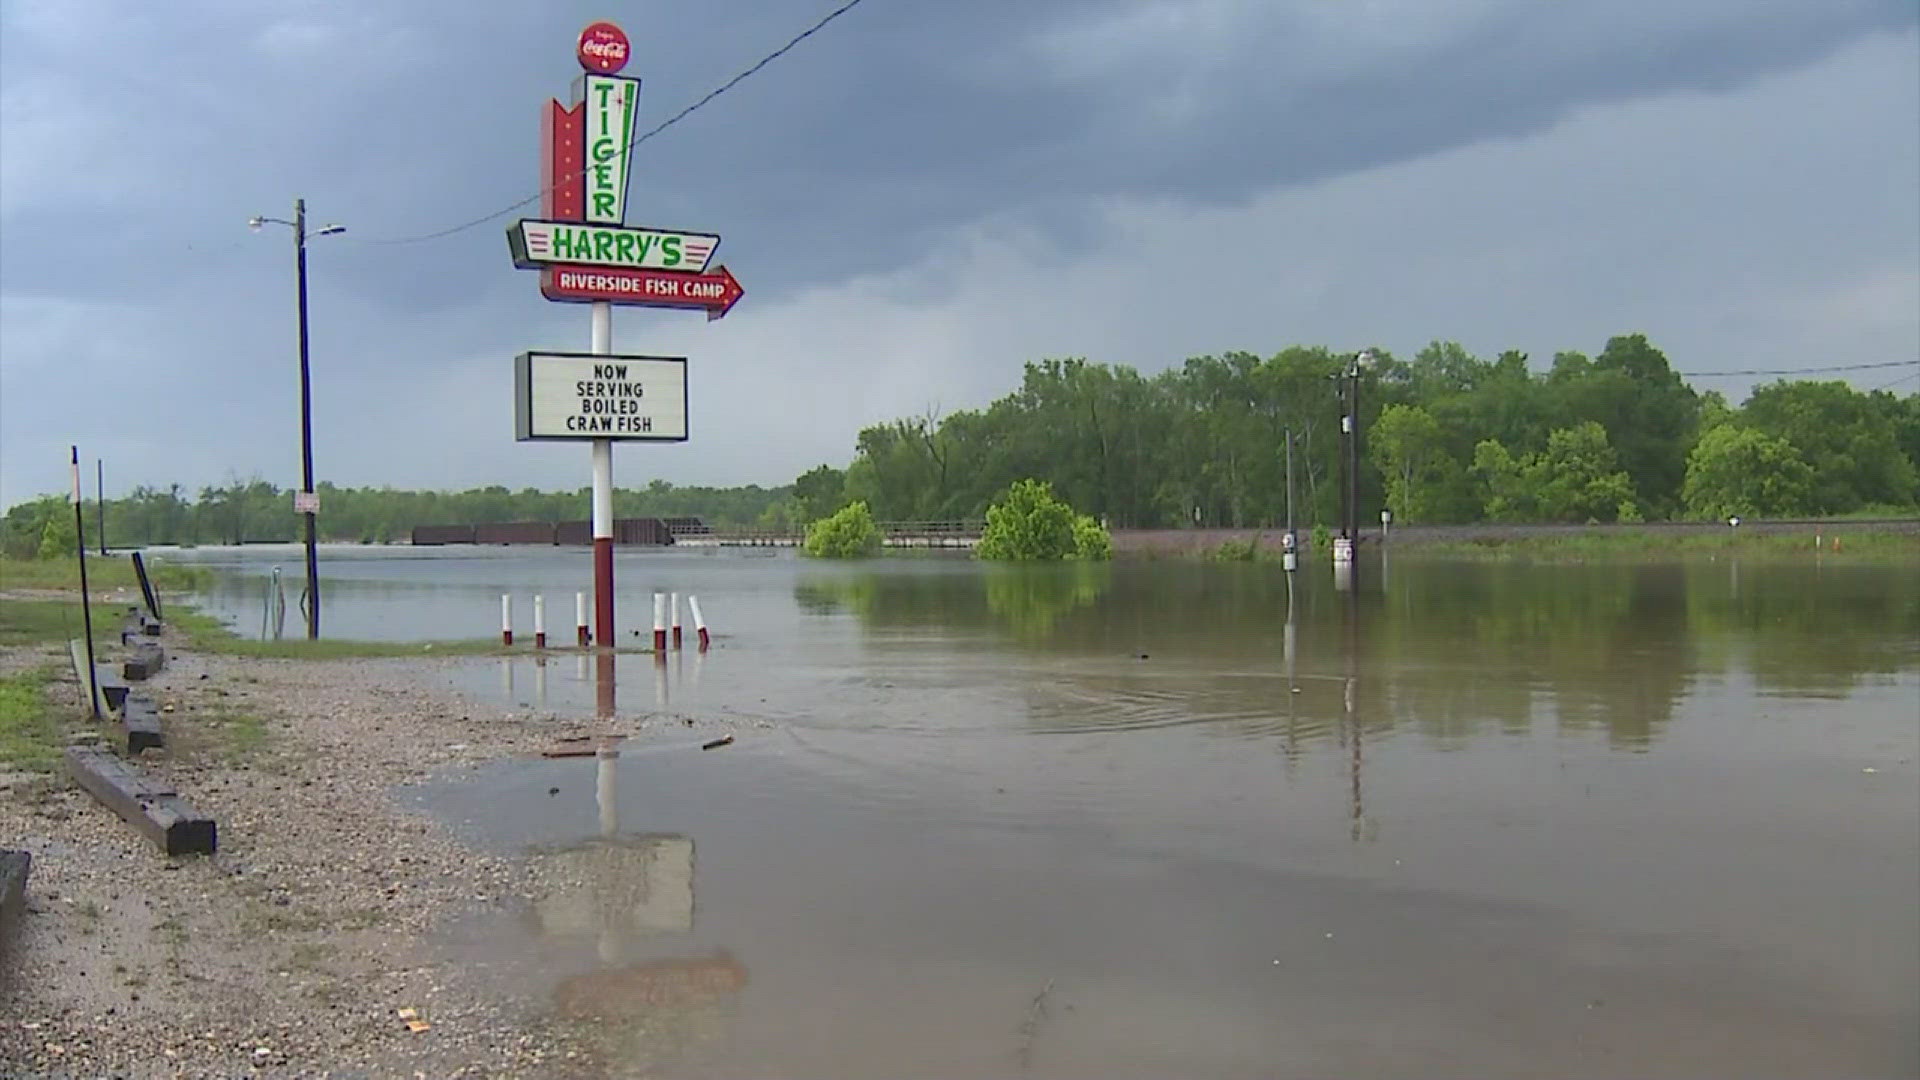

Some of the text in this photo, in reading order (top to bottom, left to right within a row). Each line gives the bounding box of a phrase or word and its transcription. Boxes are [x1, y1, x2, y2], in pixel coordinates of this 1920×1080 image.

[593, 84, 615, 217] TIGER
[553, 228, 681, 264] HARRY'S
[560, 273, 725, 298] RIVERSIDE FISH CAMP
[594, 365, 627, 379] NOW
[577, 382, 643, 397] SERVING
[582, 399, 638, 414] BOILED
